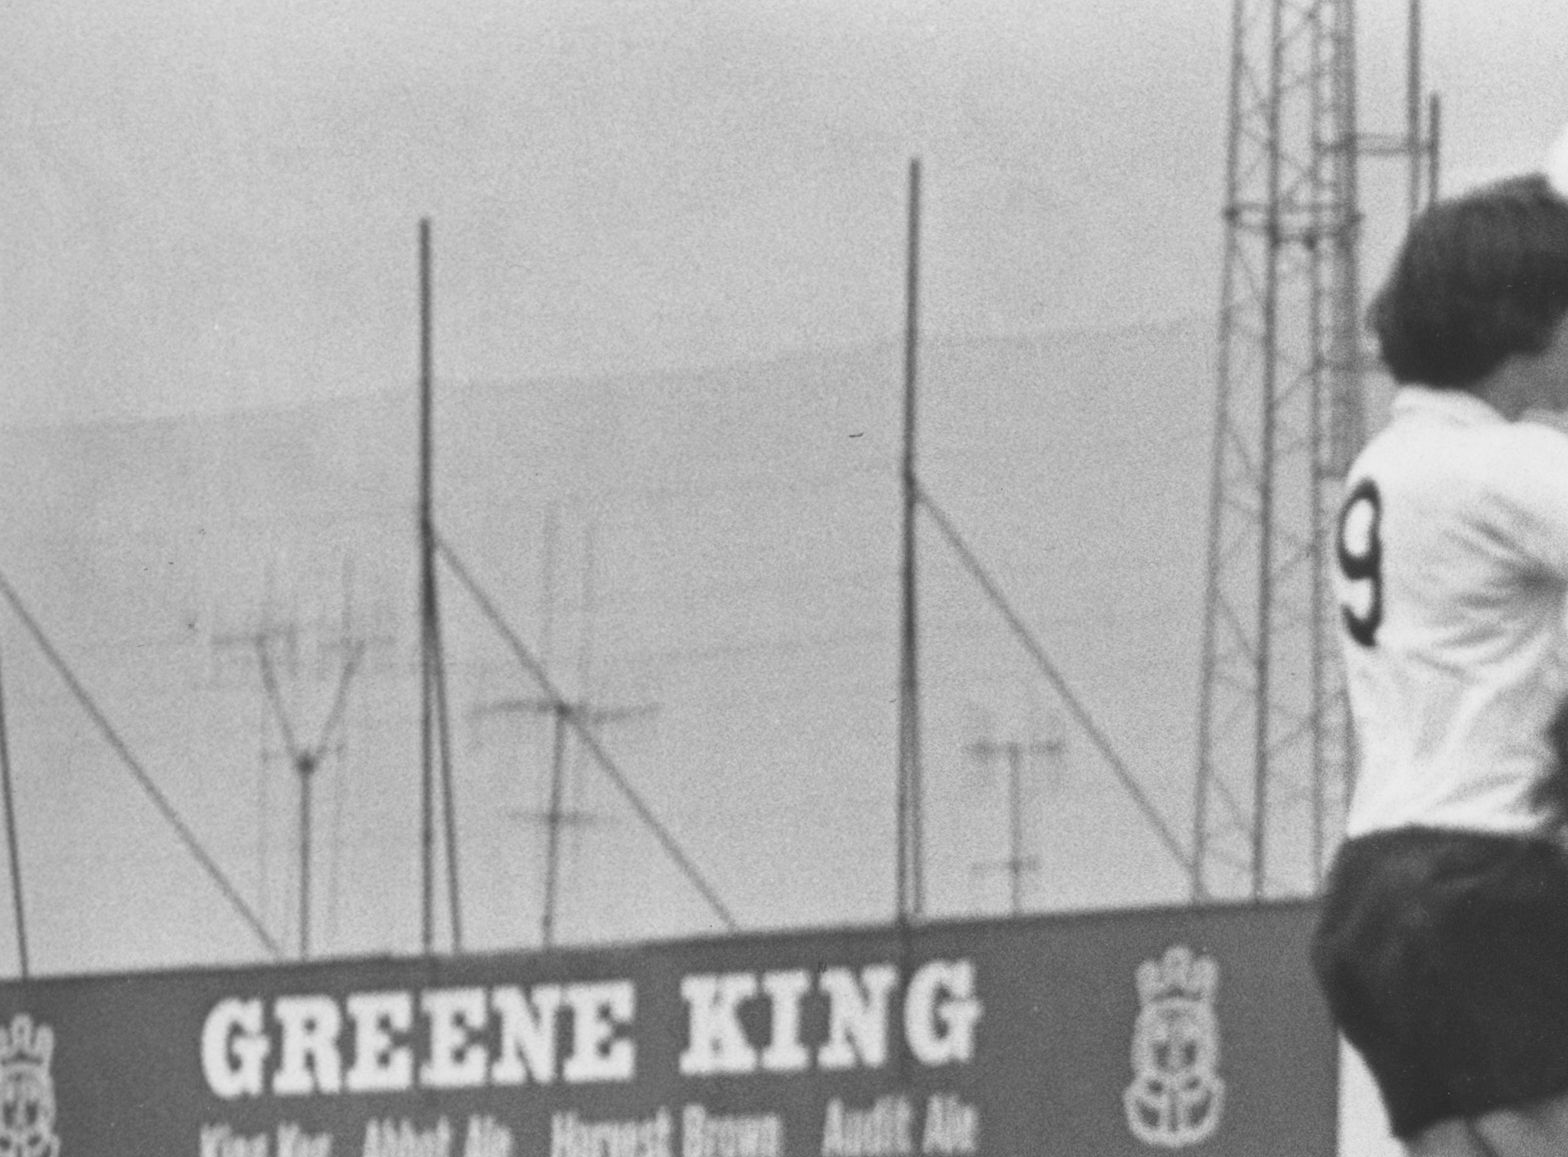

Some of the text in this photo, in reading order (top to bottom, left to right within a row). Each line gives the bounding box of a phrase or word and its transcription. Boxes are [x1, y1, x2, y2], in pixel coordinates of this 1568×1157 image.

[1336, 477, 1384, 649] 9
[201, 960, 983, 1098] GREENE KING
